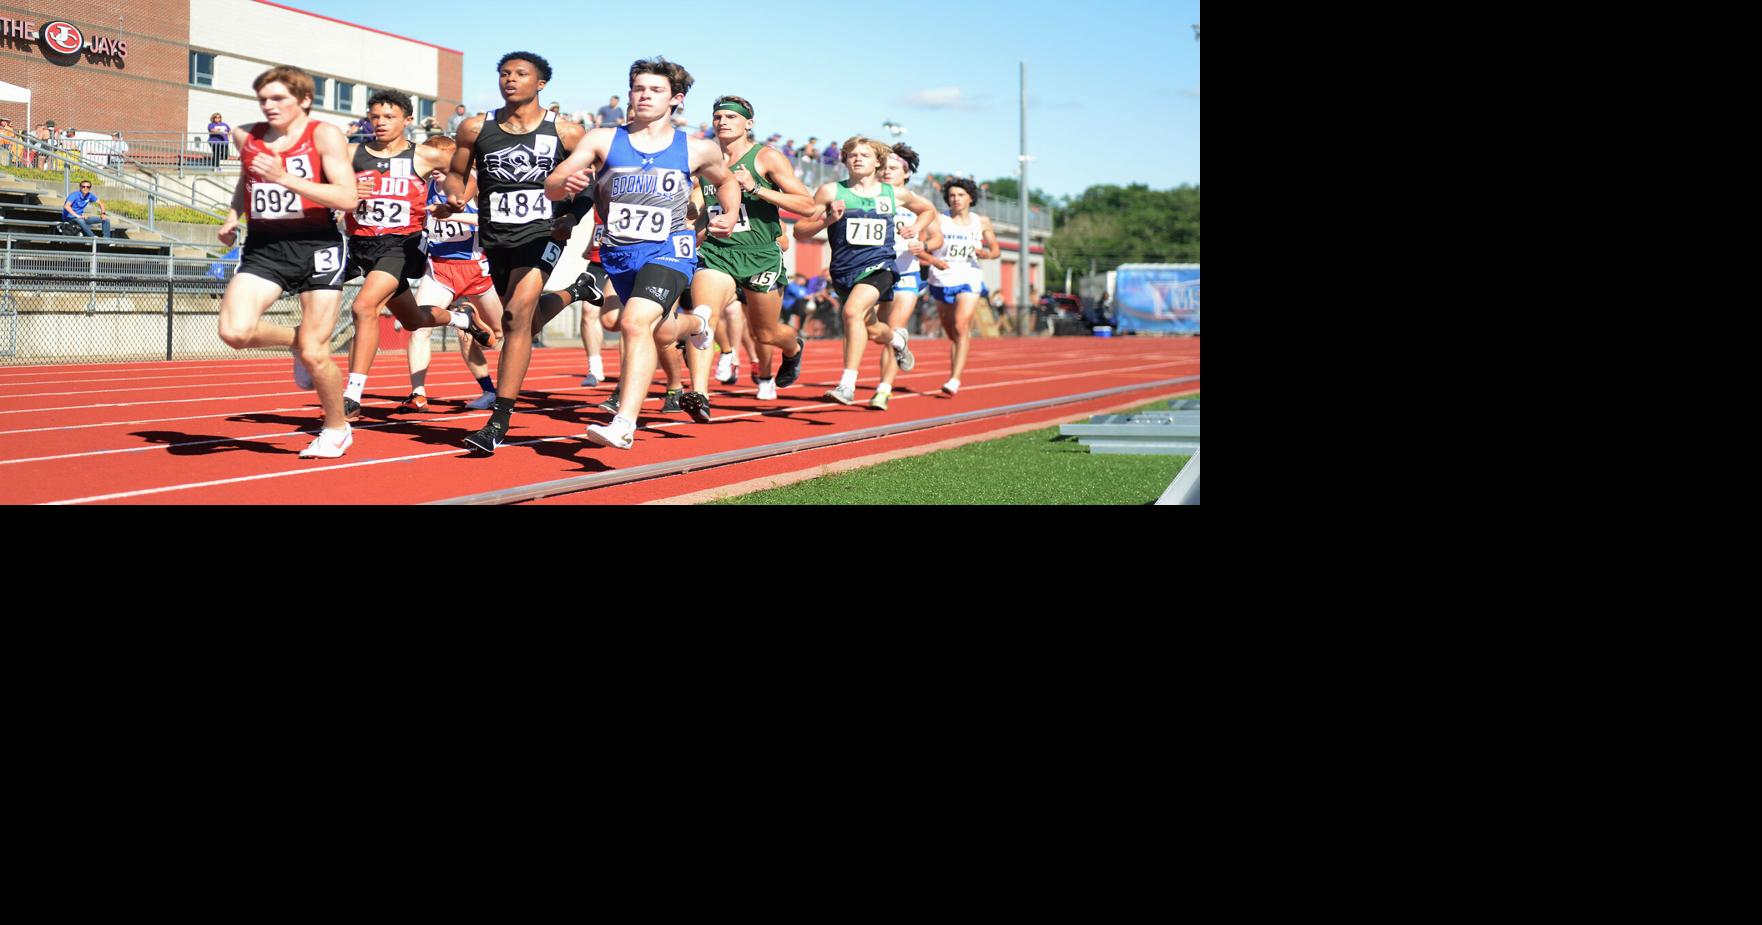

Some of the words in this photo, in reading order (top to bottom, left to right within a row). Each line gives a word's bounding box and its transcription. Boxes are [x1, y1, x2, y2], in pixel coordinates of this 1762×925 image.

[0, 17, 36, 41] THE
[89, 35, 128, 58] JAYS
[291, 158, 307, 178] 3
[662, 171, 676, 192] 6
[255, 188, 299, 213] 692
[498, 192, 547, 218] 484
[356, 200, 402, 223] 452
[619, 207, 665, 233] 379
[434, 219, 464, 238] 451
[848, 222, 884, 241] 718
[546, 245, 560, 263] 5
[679, 236, 691, 257] 6
[949, 244, 976, 258] 542
[320, 249, 333, 271] 3
[756, 272, 773, 285] 15
